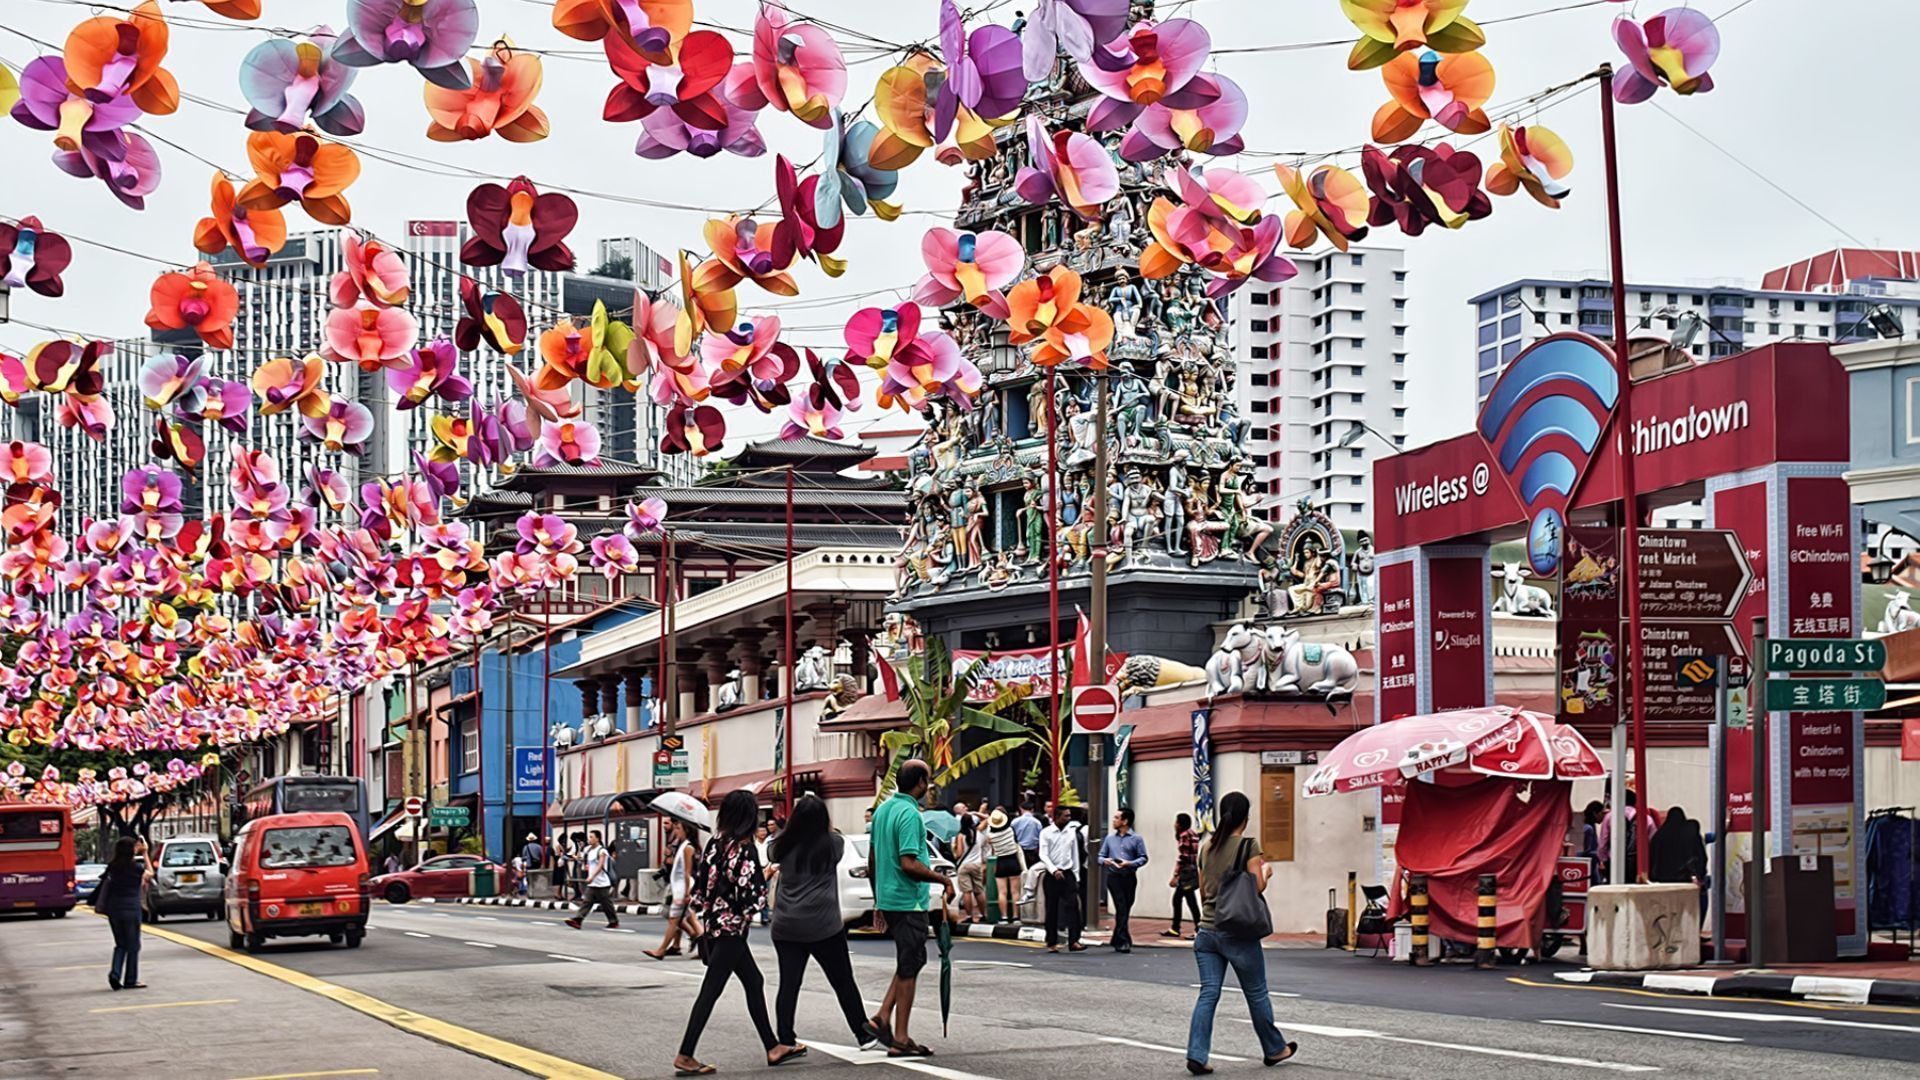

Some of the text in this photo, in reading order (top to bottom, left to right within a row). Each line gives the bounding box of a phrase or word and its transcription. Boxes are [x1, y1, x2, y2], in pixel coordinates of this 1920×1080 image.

[1395, 462, 1489, 515] Wireless @
[1796, 524, 1843, 537] Free Wi-Fi
[1638, 534, 1687, 548] Chinatown
[1663, 551, 1697, 565] Market
[1790, 550, 1849, 563] @Chinatown
[1810, 592, 1833, 608] 免费
[1438, 611, 1466, 619] Powered
[1793, 617, 1850, 634] 无线互联网
[1641, 627, 1690, 641] Chinatown
[1450, 634, 1481, 649] SingTel
[1671, 645, 1703, 657] Centre
[1772, 643, 1875, 669] Pagoda St
[1793, 684, 1861, 705] 宝塔街
[1801, 724, 1842, 736] interest in
[1800, 745, 1844, 757] Chinatown
[1415, 752, 1453, 774] HAPPY
[1794, 765, 1850, 779] with the map!
[1348, 772, 1385, 789] SHARE
